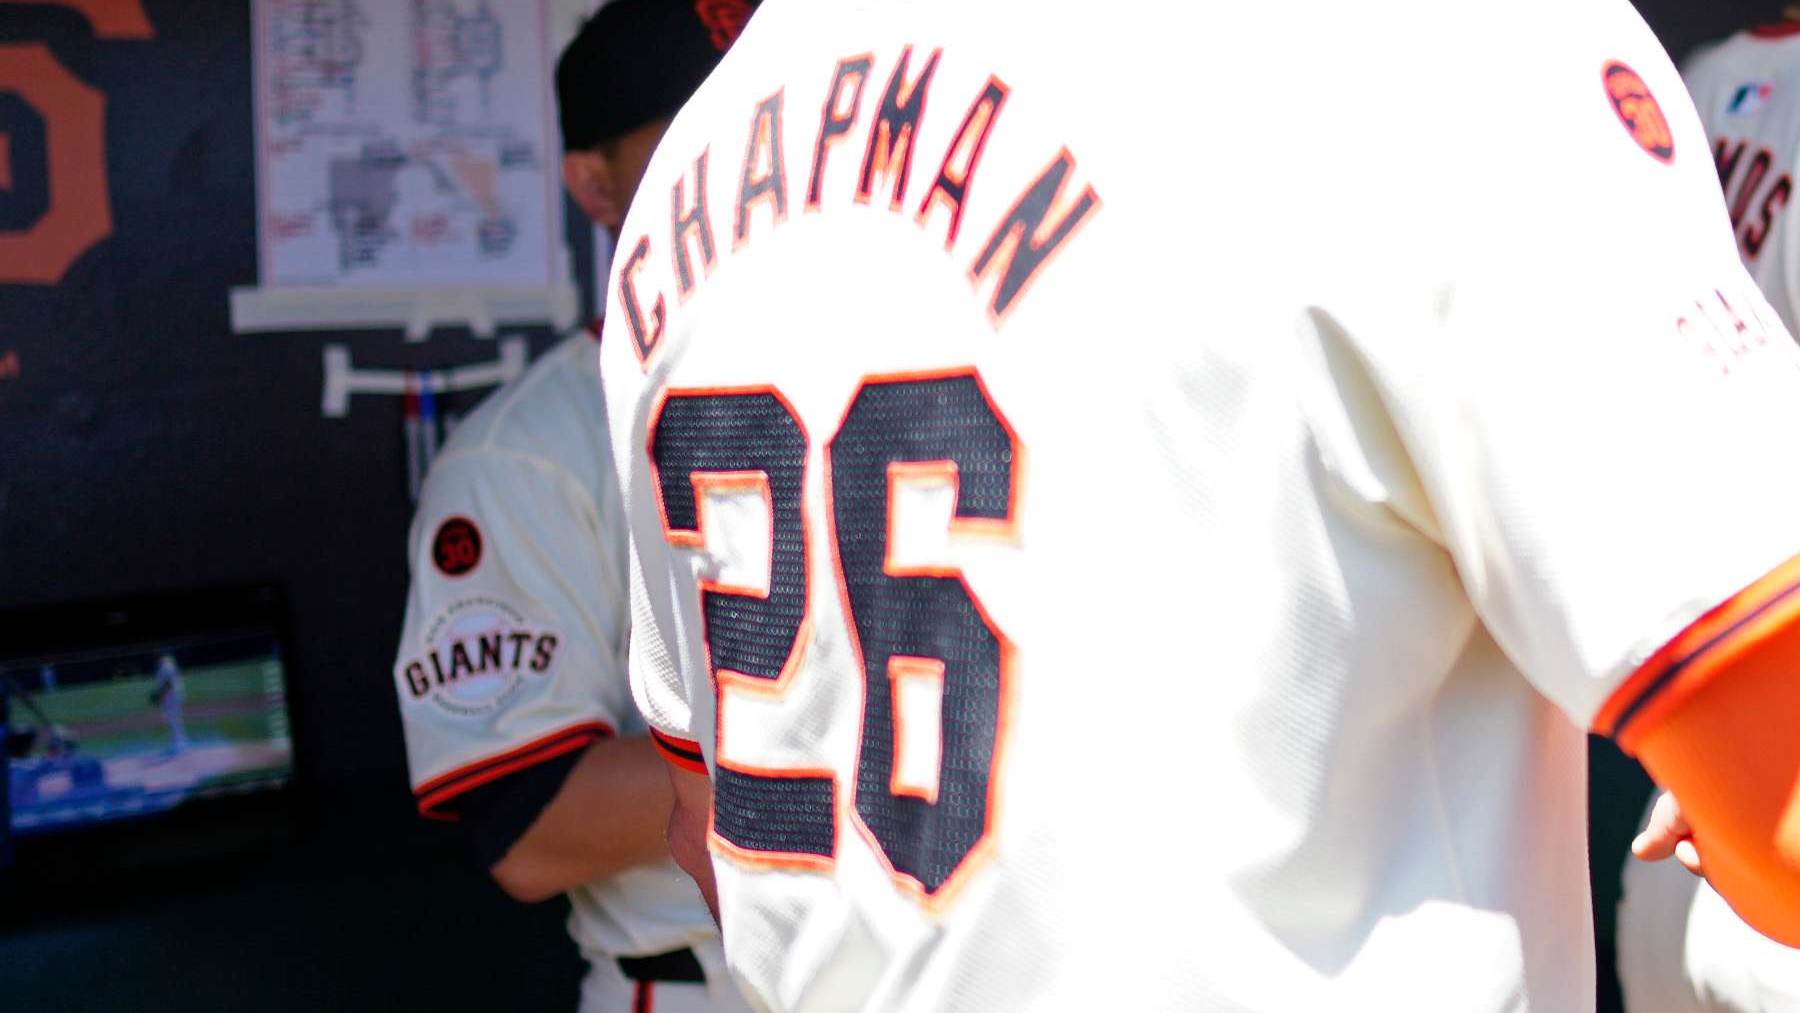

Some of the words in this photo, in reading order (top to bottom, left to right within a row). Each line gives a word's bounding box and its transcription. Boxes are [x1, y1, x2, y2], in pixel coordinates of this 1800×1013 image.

[618, 43, 1103, 374] CHAPMAN
[404, 631, 558, 699] GIANTS
[647, 365, 1028, 923] 26
